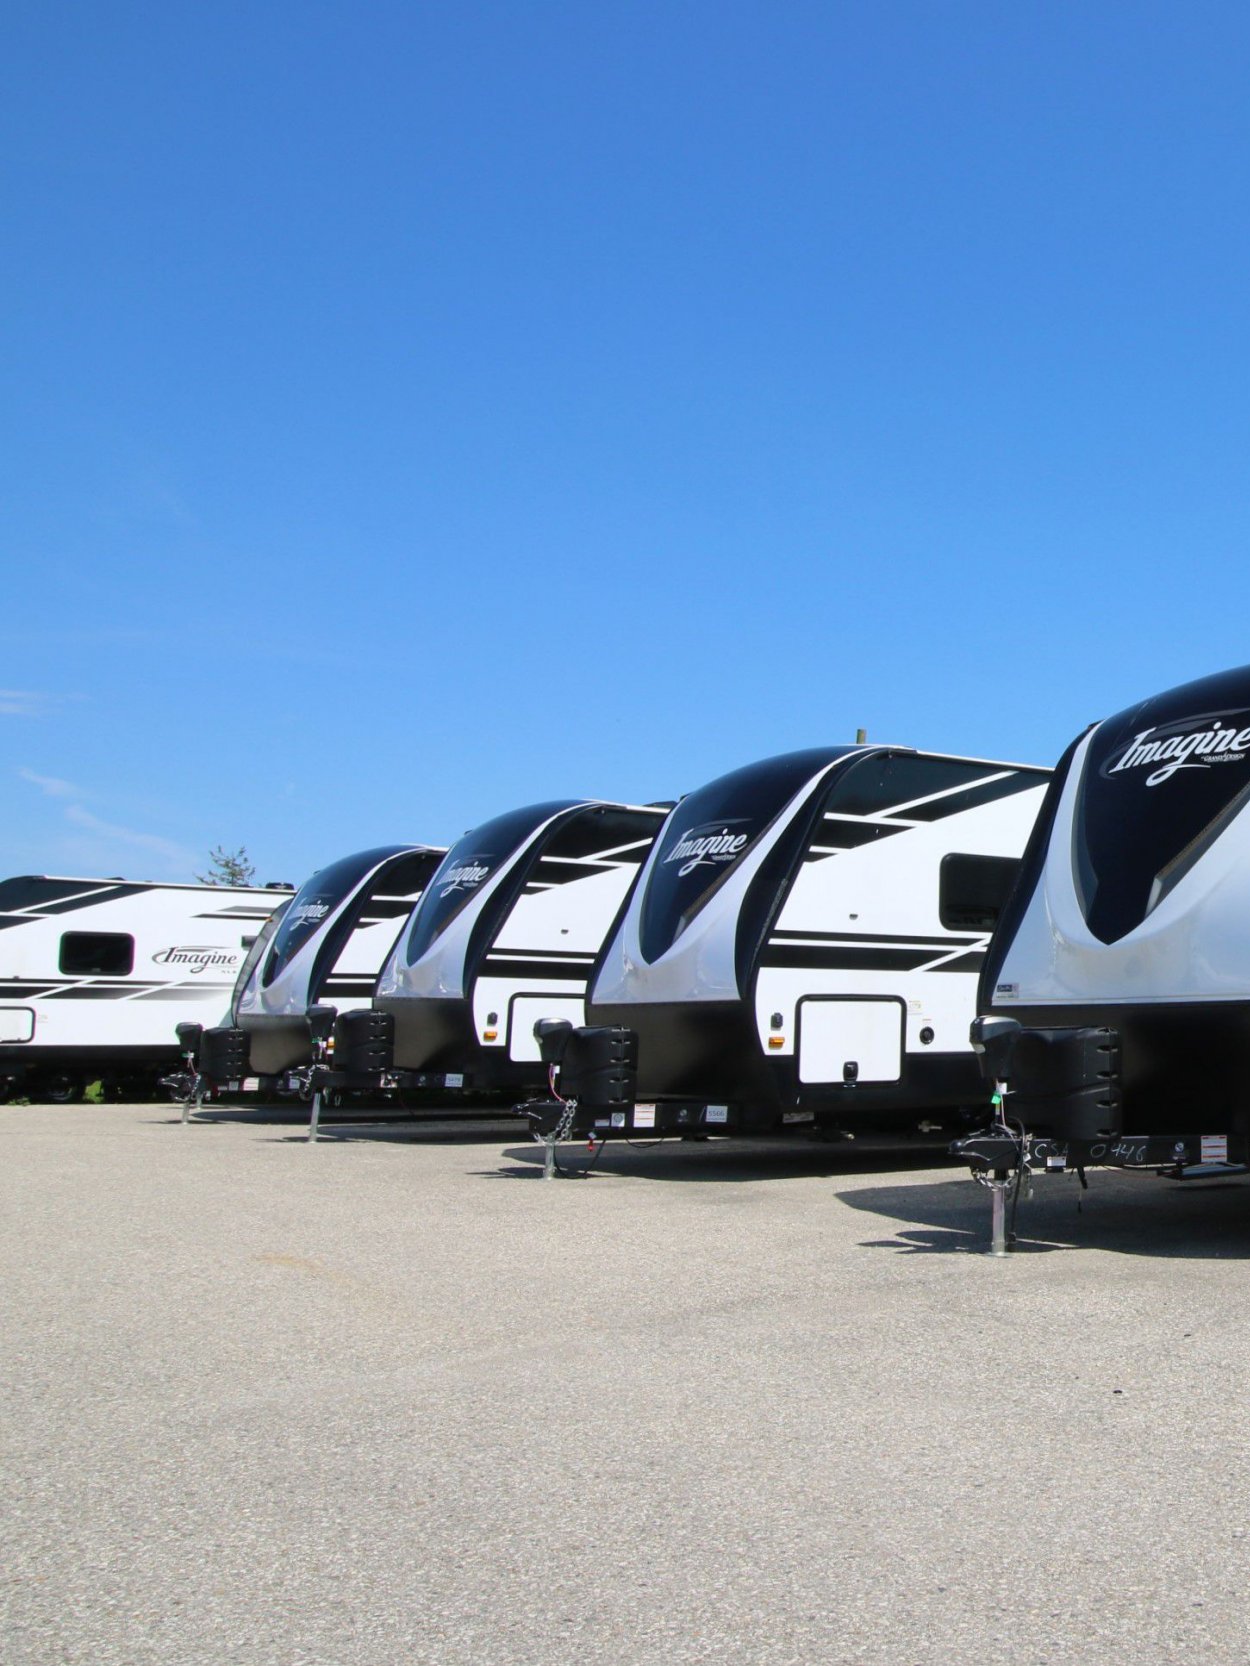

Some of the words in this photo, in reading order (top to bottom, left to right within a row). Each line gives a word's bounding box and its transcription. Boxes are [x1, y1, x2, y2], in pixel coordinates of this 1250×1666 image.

[663, 828, 748, 878] Imagine
[436, 859, 489, 898] Imagine
[160, 946, 238, 974] Imagine
